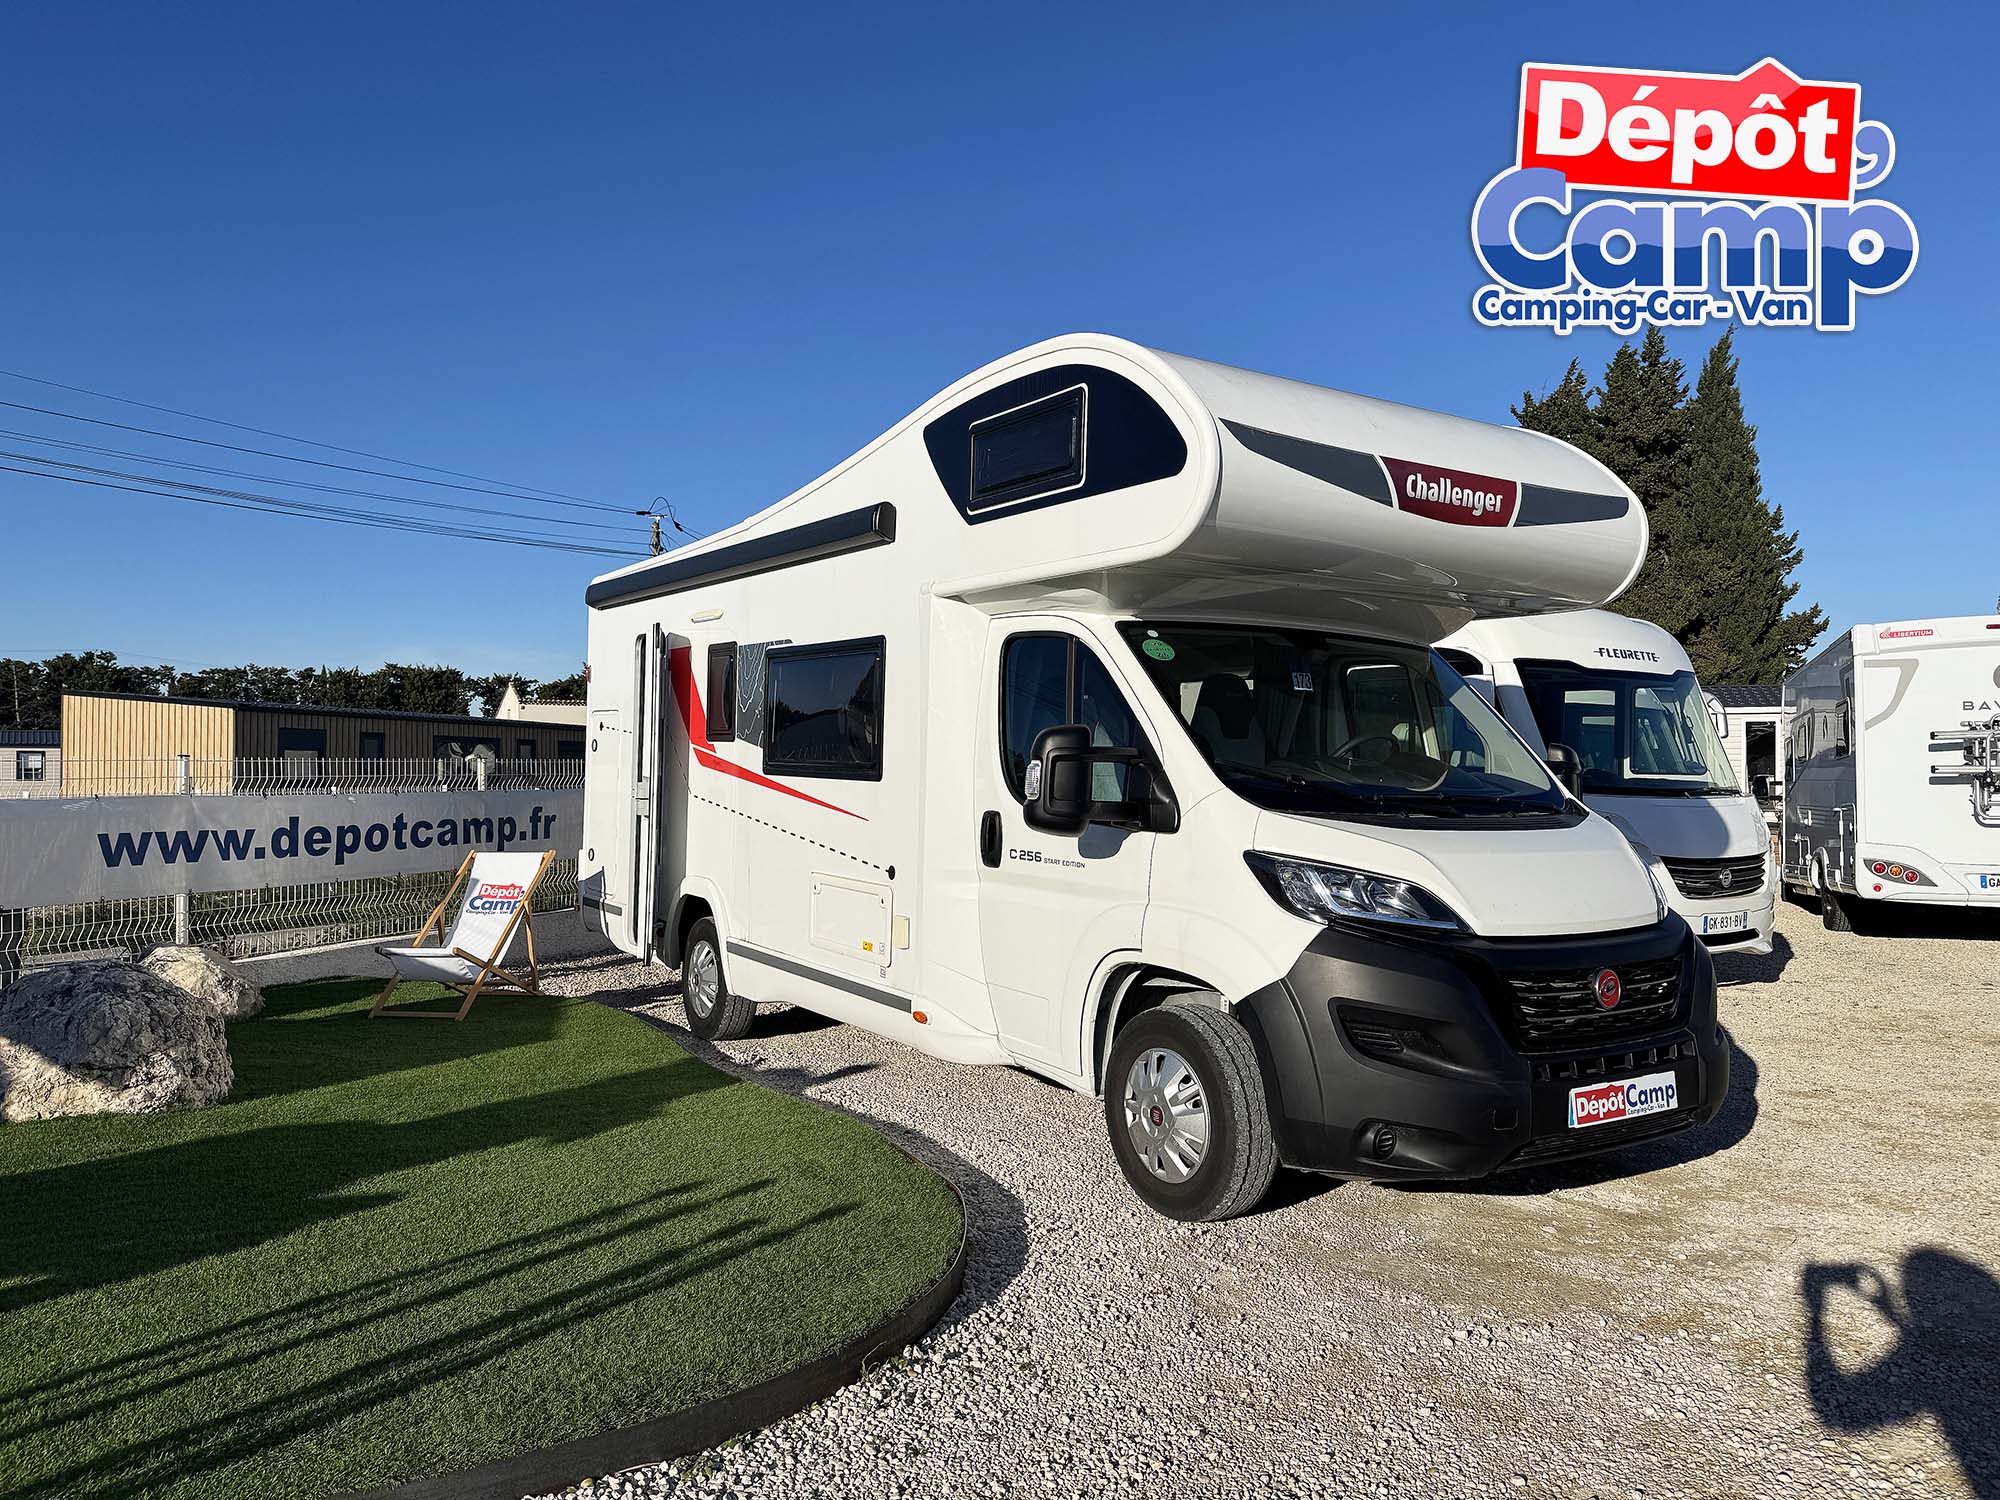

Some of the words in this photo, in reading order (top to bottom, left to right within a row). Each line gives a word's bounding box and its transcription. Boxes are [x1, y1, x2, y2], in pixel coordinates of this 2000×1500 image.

[1406, 473, 1503, 516] Challenger
[1893, 630, 1932, 638] LIBERTIUM
[1598, 647, 1659, 663] FLEURETTE
[97, 806, 557, 868] www.depotcamp.fr
[1009, 848, 1018, 860] C
[1019, 850, 1042, 862] 256
[1062, 860, 1086, 868] EDITION
[480, 885, 520, 899] Dépôt
[1709, 914, 1743, 930] GK-831-BV
[1576, 1090, 1625, 1119] Dépôt
[1625, 1083, 1676, 1108] Camp
